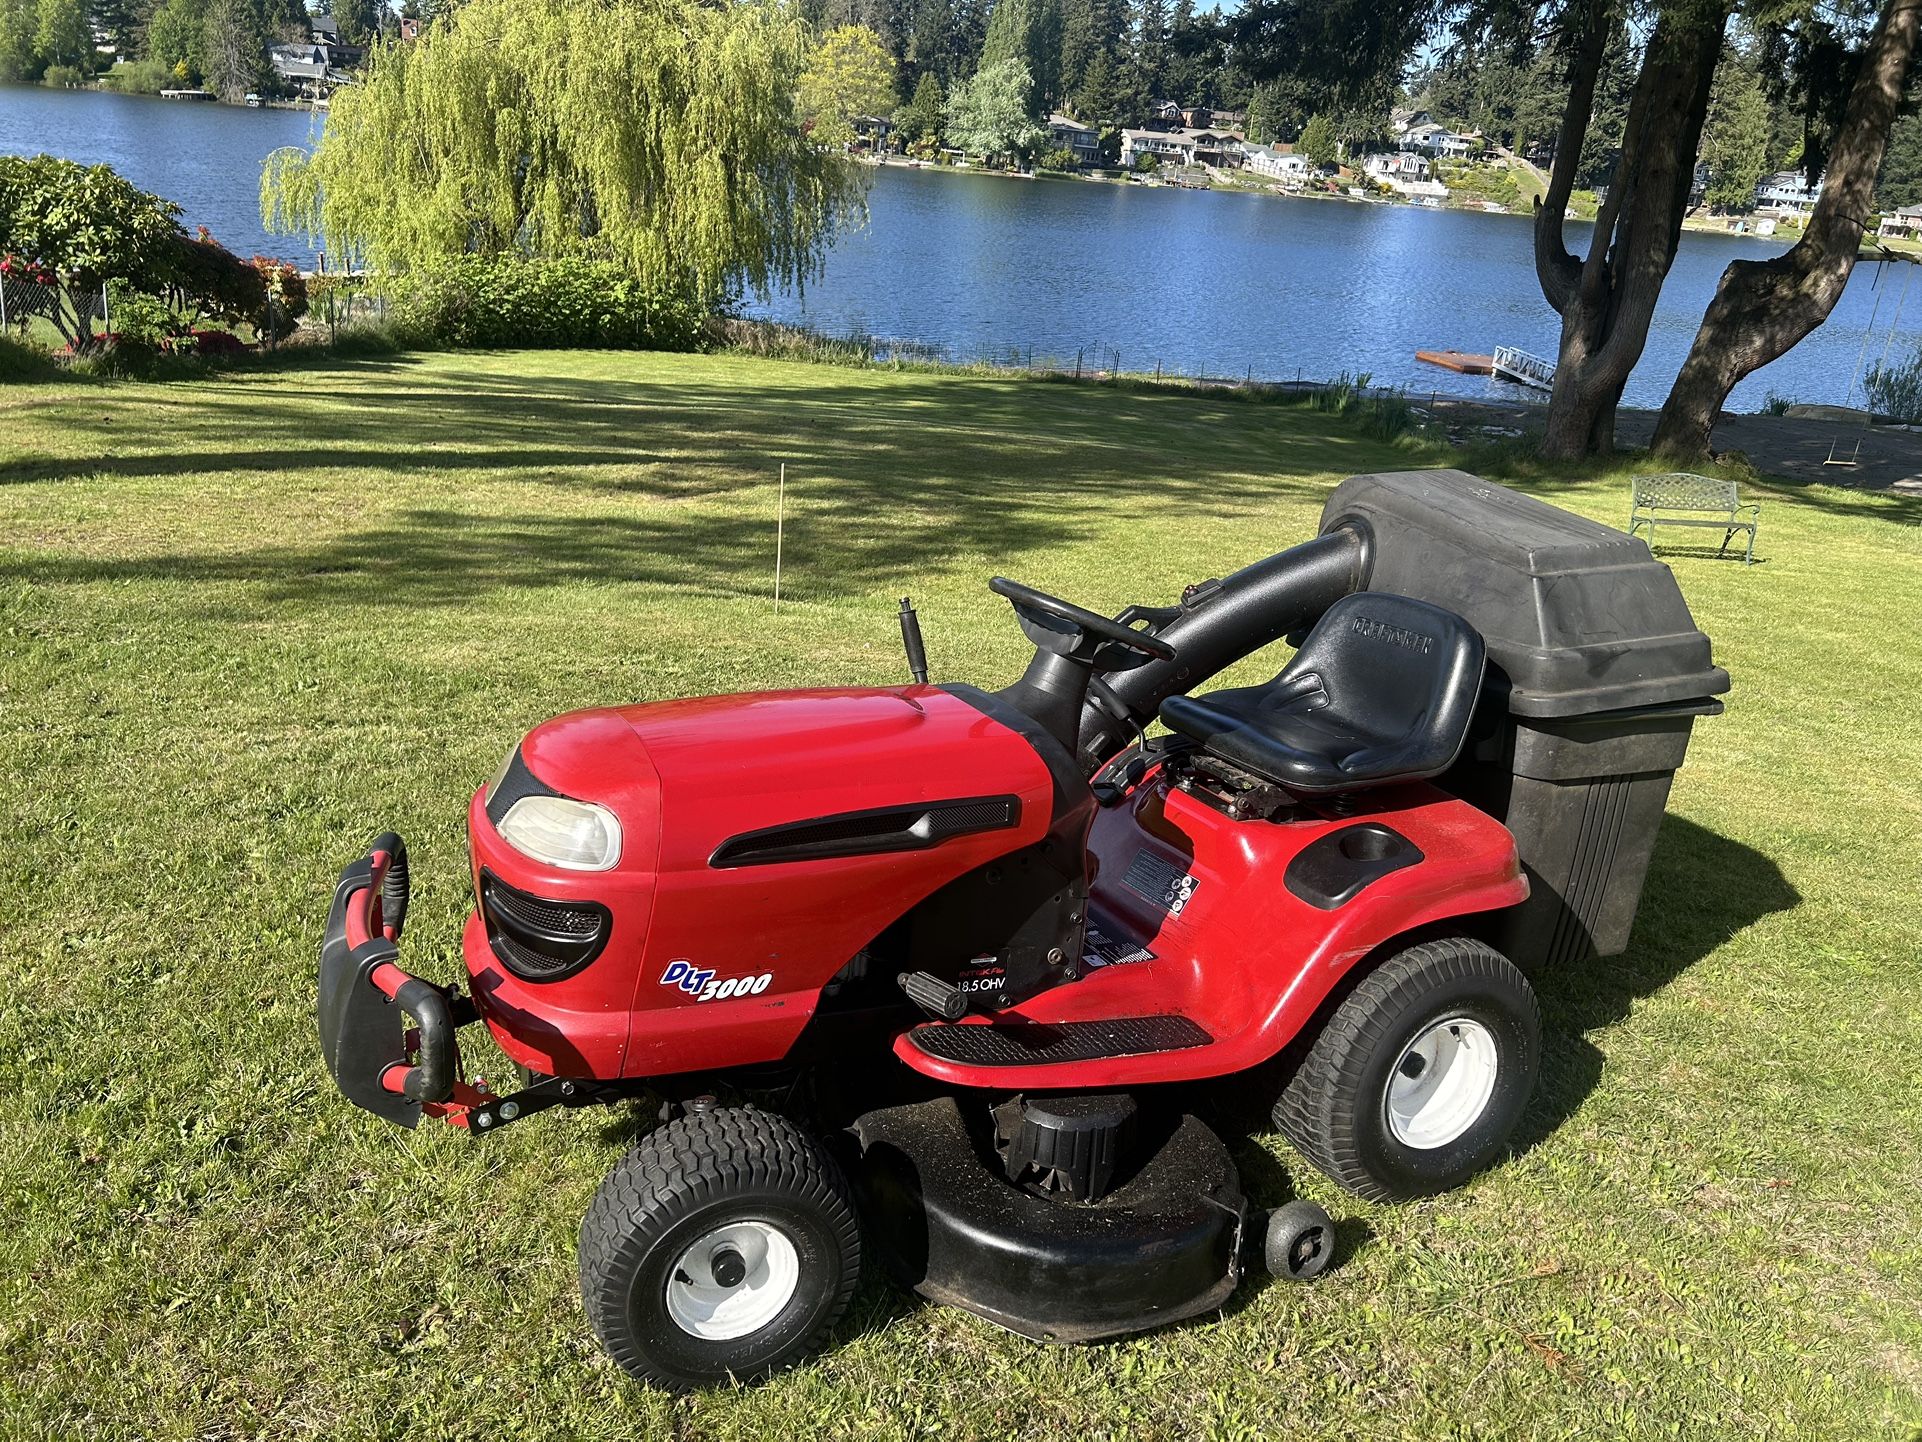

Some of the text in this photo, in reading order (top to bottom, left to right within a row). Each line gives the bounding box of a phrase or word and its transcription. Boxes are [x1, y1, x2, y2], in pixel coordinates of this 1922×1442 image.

[1352, 616, 1433, 655] CRAFTSMAN
[660, 961, 773, 1002] DLT 3000
[958, 977, 1006, 993] 18.5 OHV
